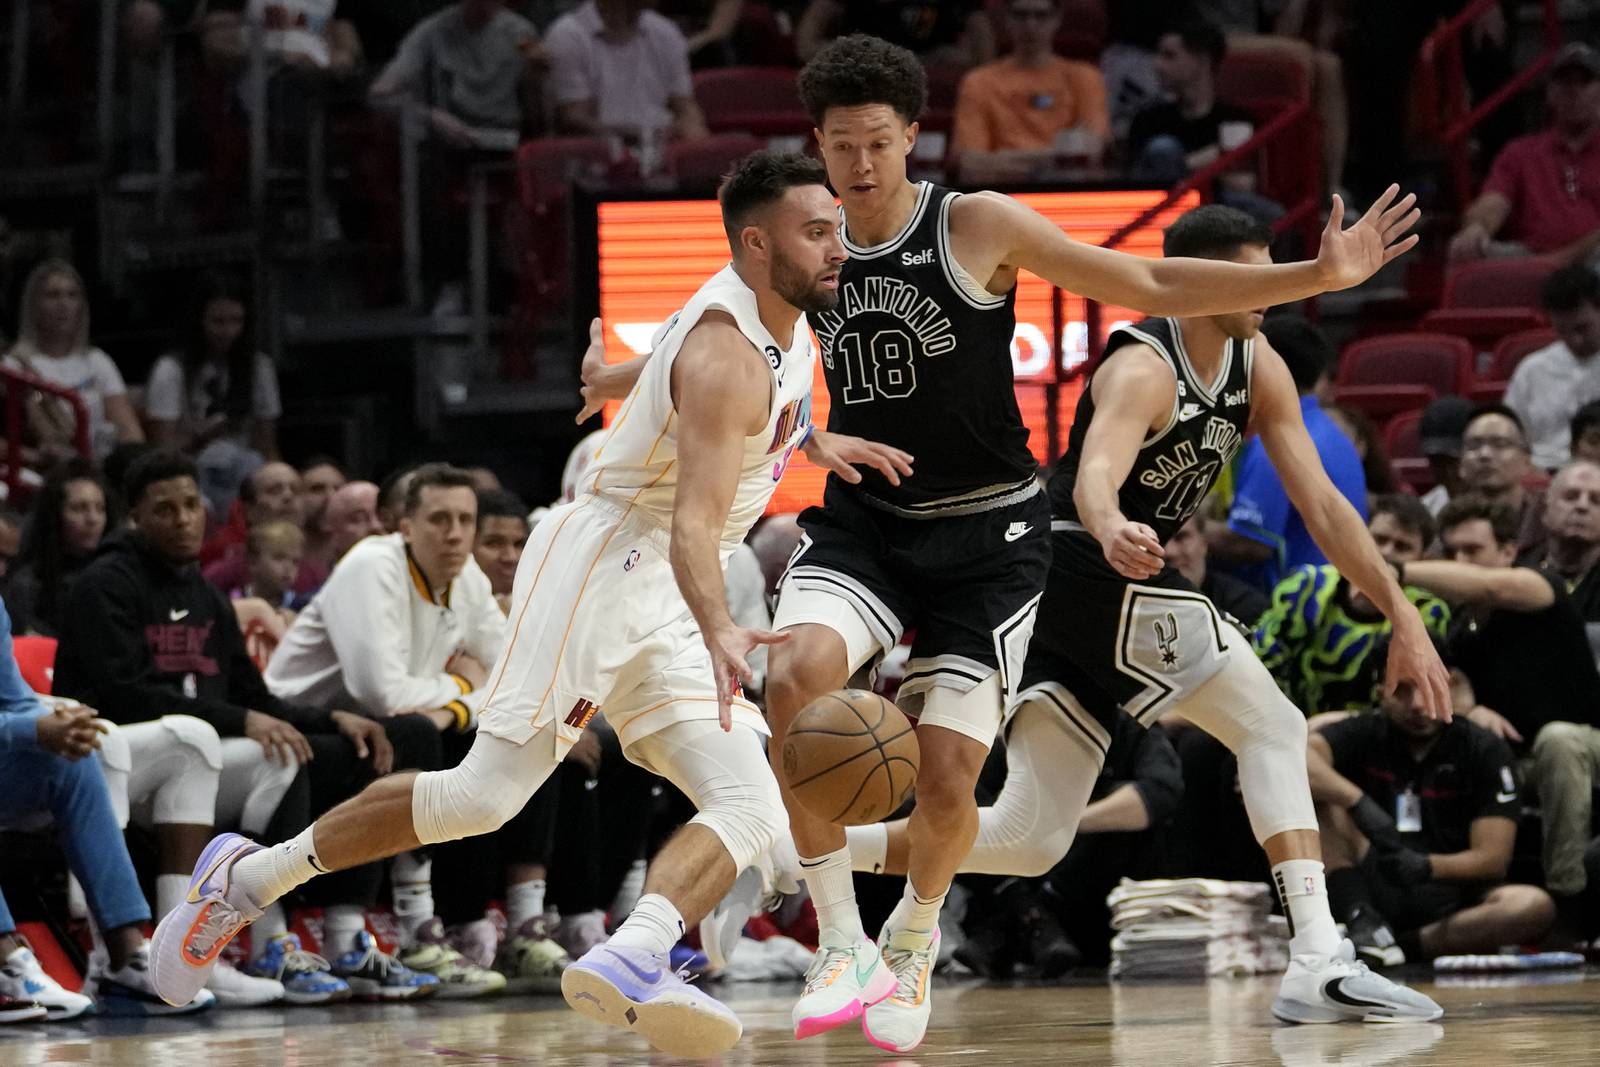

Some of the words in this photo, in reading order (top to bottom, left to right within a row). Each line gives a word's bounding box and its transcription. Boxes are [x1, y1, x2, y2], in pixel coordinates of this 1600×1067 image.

[901, 248, 936, 266] Self.
[844, 276, 957, 358] ANTONIO
[838, 329, 918, 405] 18
[1140, 440, 1198, 489] SAN
